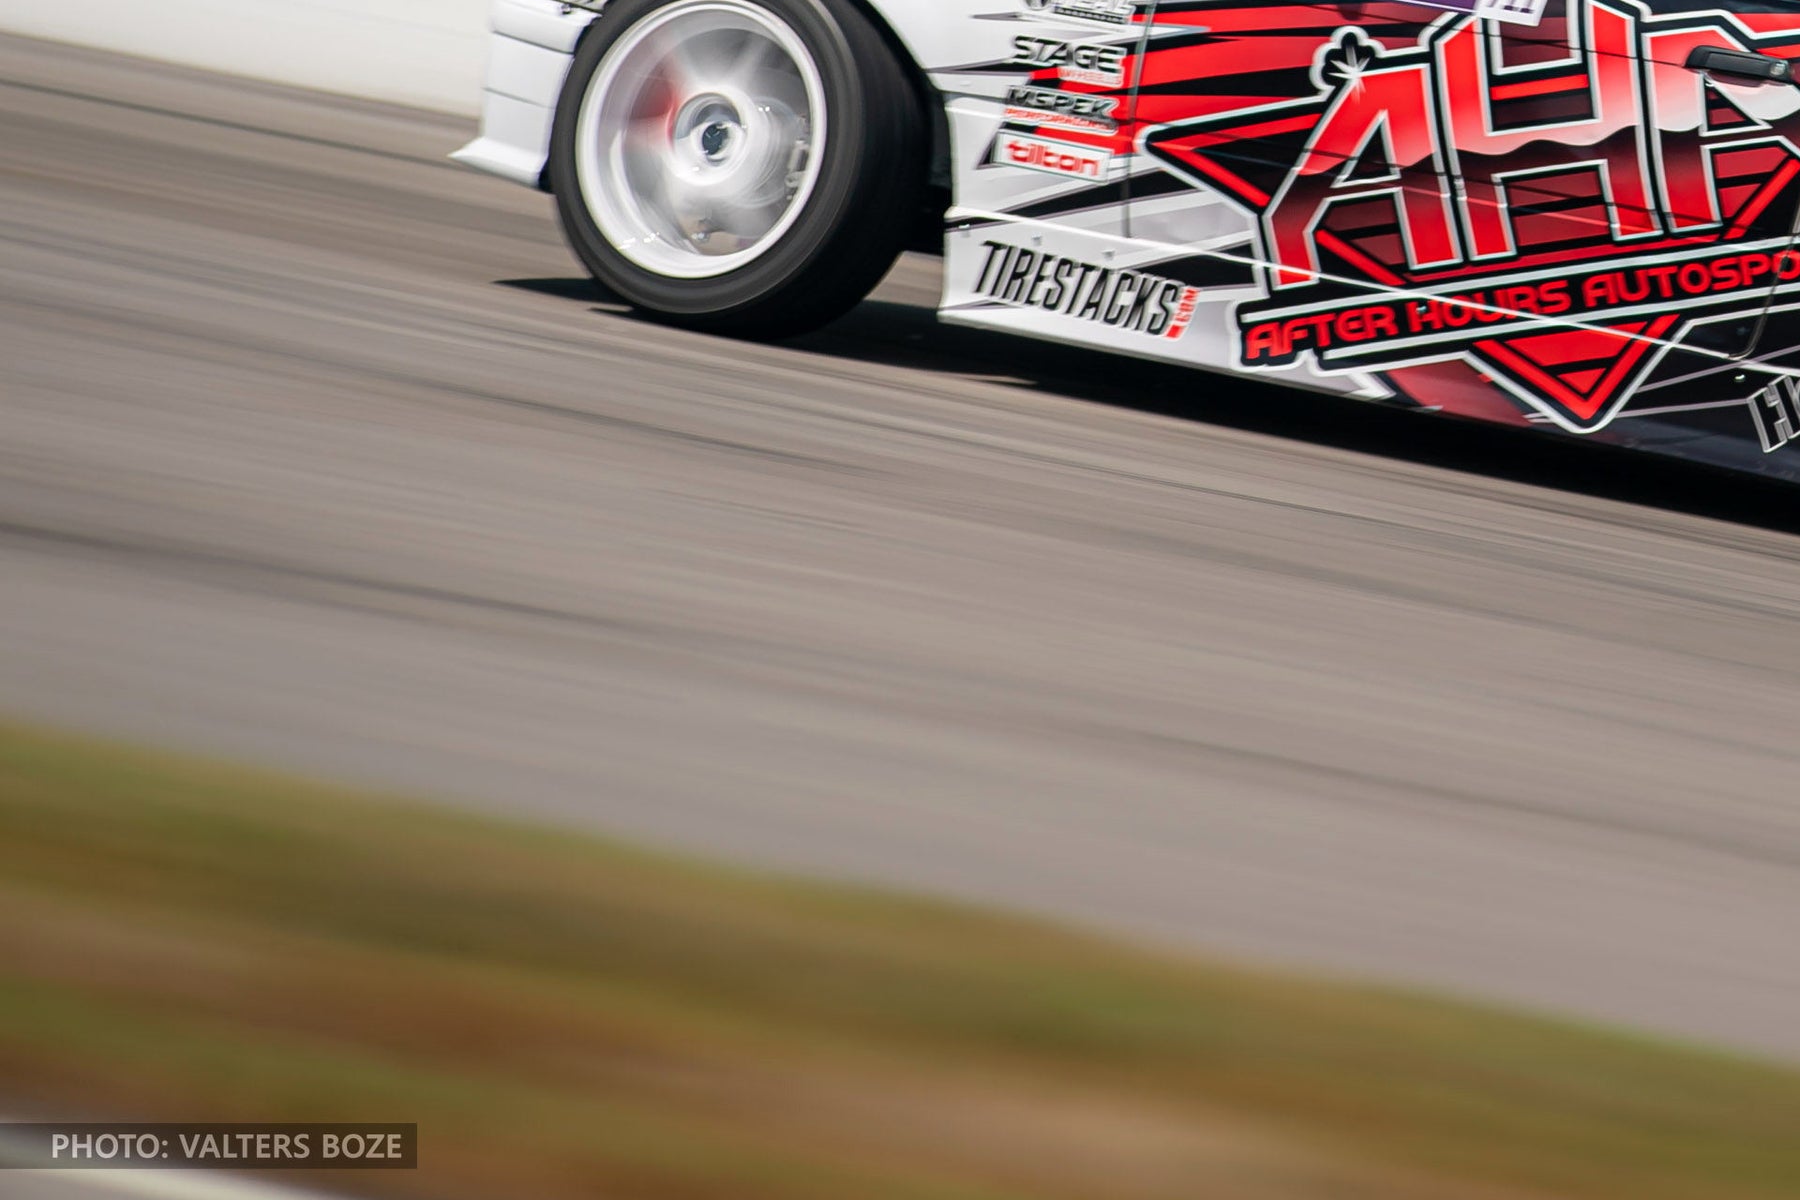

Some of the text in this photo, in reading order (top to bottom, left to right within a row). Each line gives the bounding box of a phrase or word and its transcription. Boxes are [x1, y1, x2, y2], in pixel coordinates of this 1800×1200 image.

[1011, 34, 1125, 74] STAGE
[1005, 141, 1101, 177] tilton
[973, 240, 1183, 336] TIRESTACKS
[1246, 305, 1397, 361] AFTER
[1407, 278, 1572, 332] HOURS
